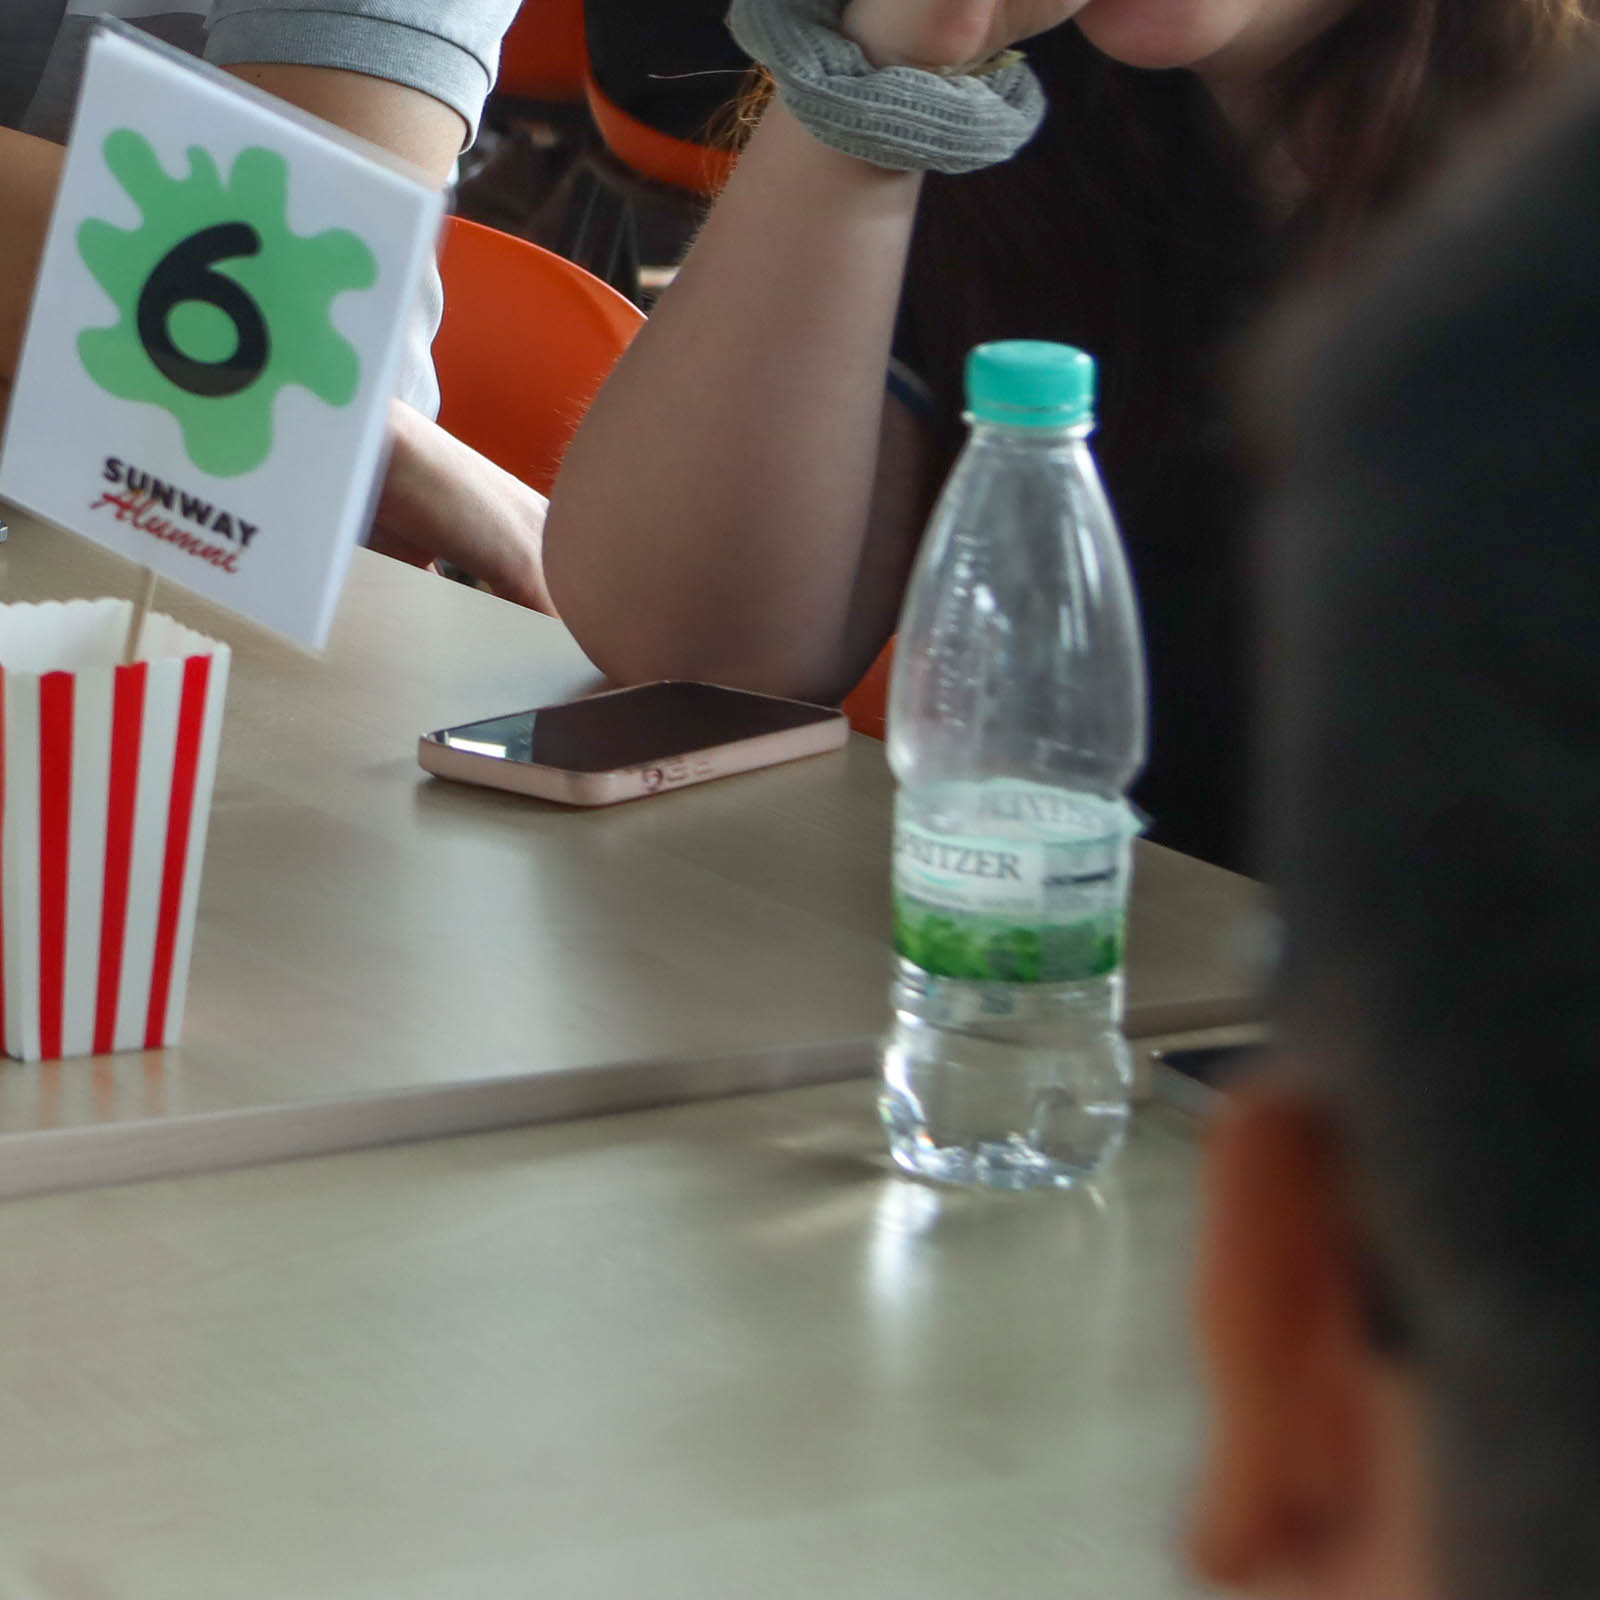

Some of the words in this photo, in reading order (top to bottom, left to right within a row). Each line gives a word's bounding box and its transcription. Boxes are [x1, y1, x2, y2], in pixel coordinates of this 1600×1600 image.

[137, 221, 272, 398] 6
[91, 487, 243, 574] Alumni
[103, 457, 258, 546] SUNWAY
